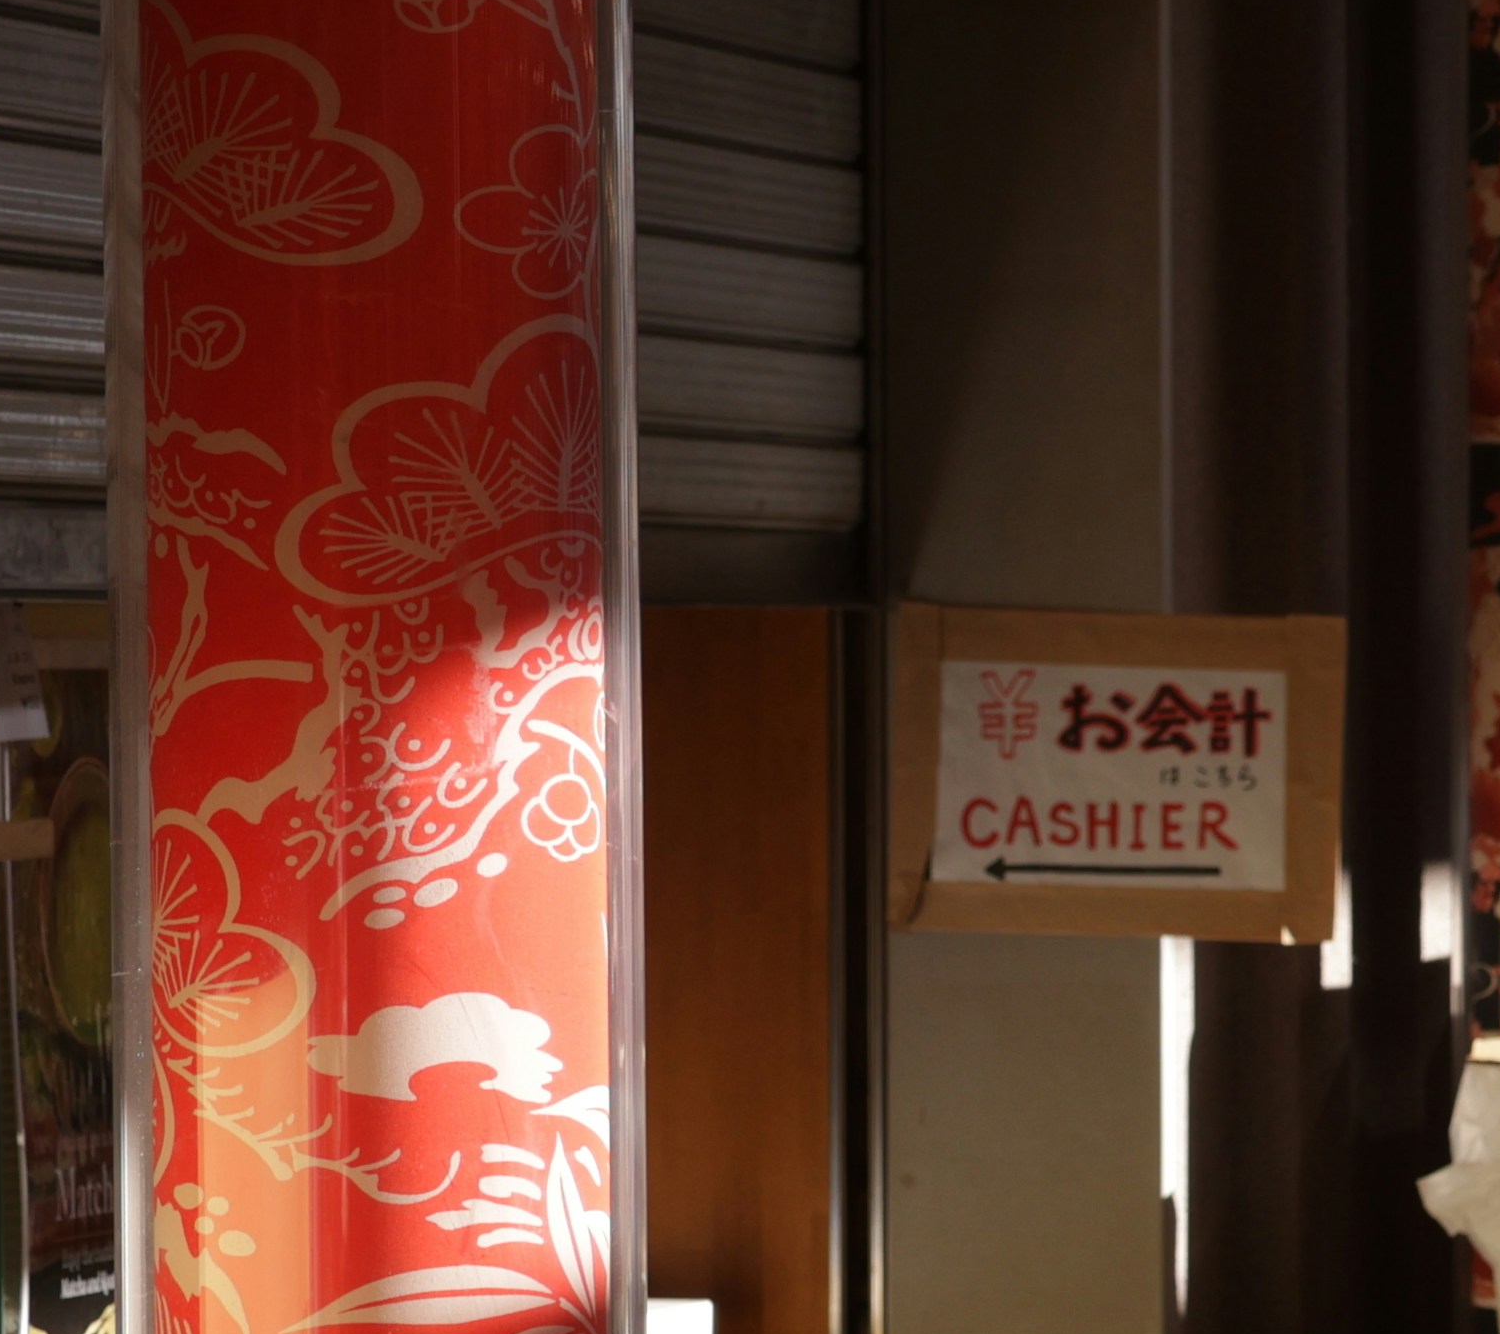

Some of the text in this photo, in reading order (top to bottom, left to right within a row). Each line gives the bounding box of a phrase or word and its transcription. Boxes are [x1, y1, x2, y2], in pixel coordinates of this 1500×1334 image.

[979, 669, 1273, 760] ¥ お会計
[961, 796, 1239, 852] CASHIER
